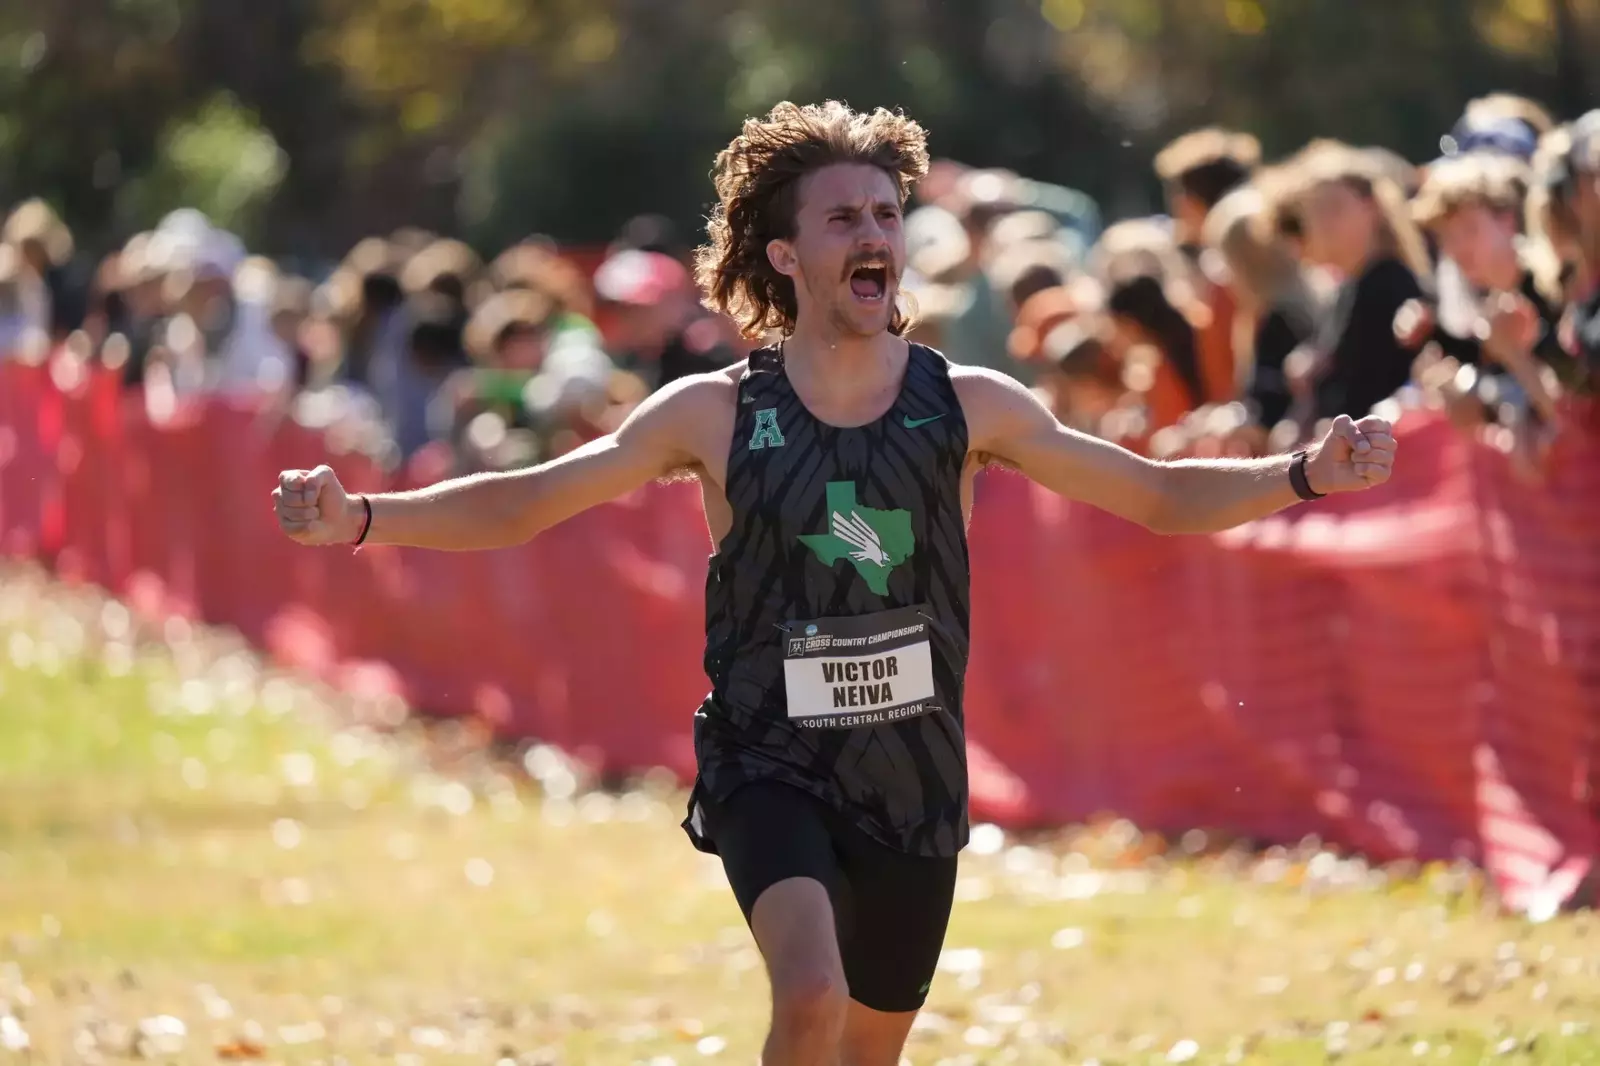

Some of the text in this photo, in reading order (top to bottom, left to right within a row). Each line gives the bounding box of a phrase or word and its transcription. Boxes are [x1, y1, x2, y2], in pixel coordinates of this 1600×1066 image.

[749, 408, 785, 449] A
[805, 639, 831, 649] CROSS
[832, 637, 867, 647] COUNTRY
[868, 624, 924, 644] CHAMPIONSHIPS
[821, 656, 898, 683] VICTOR
[833, 682, 894, 708] NEIVA
[803, 704, 923, 729] SOUTH CENTRAL REGION
